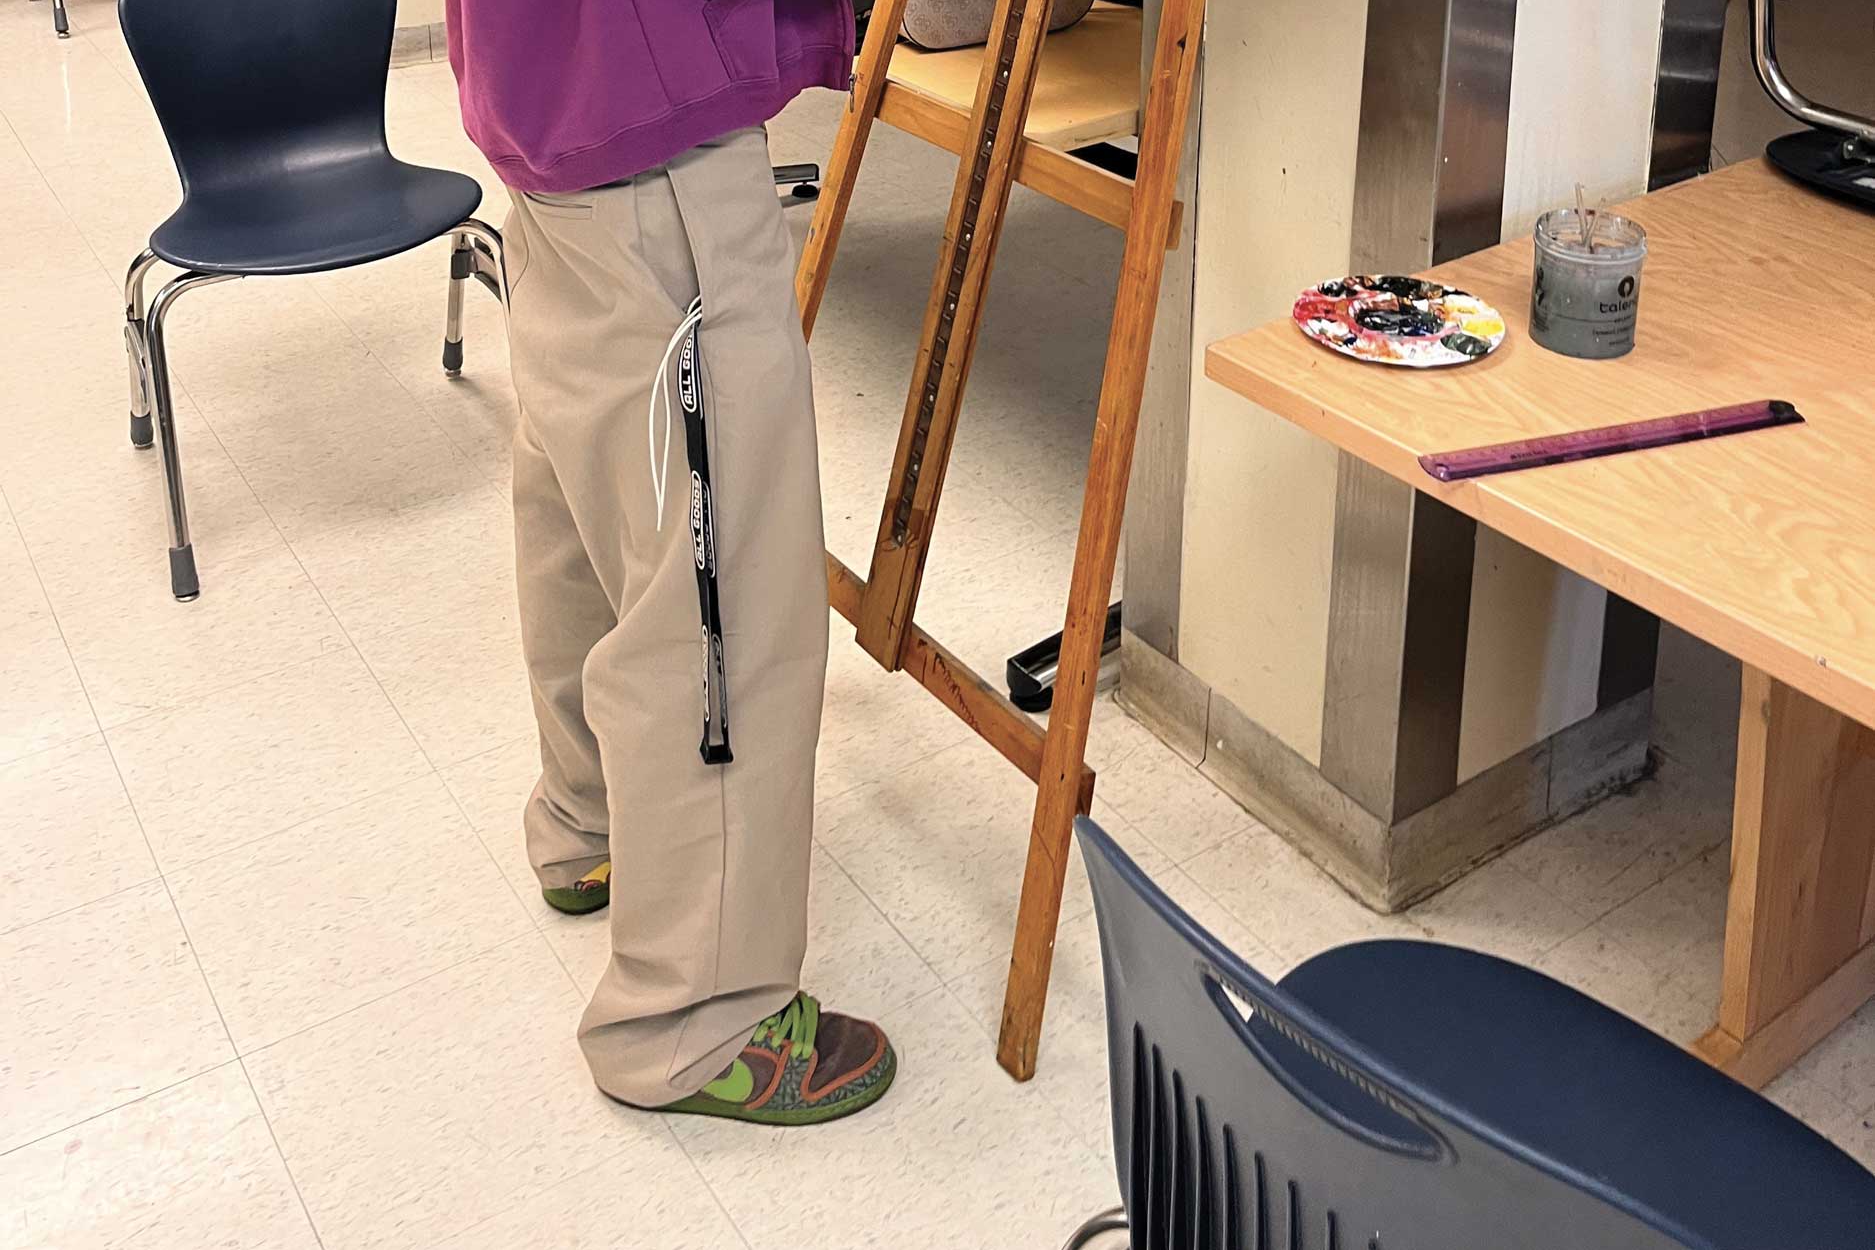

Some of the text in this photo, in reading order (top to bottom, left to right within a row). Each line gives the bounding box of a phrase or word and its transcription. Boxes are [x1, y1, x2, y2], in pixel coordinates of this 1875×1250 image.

[683, 335, 693, 405] ALL GOO
[693, 480, 703, 562] ALL GOODS
